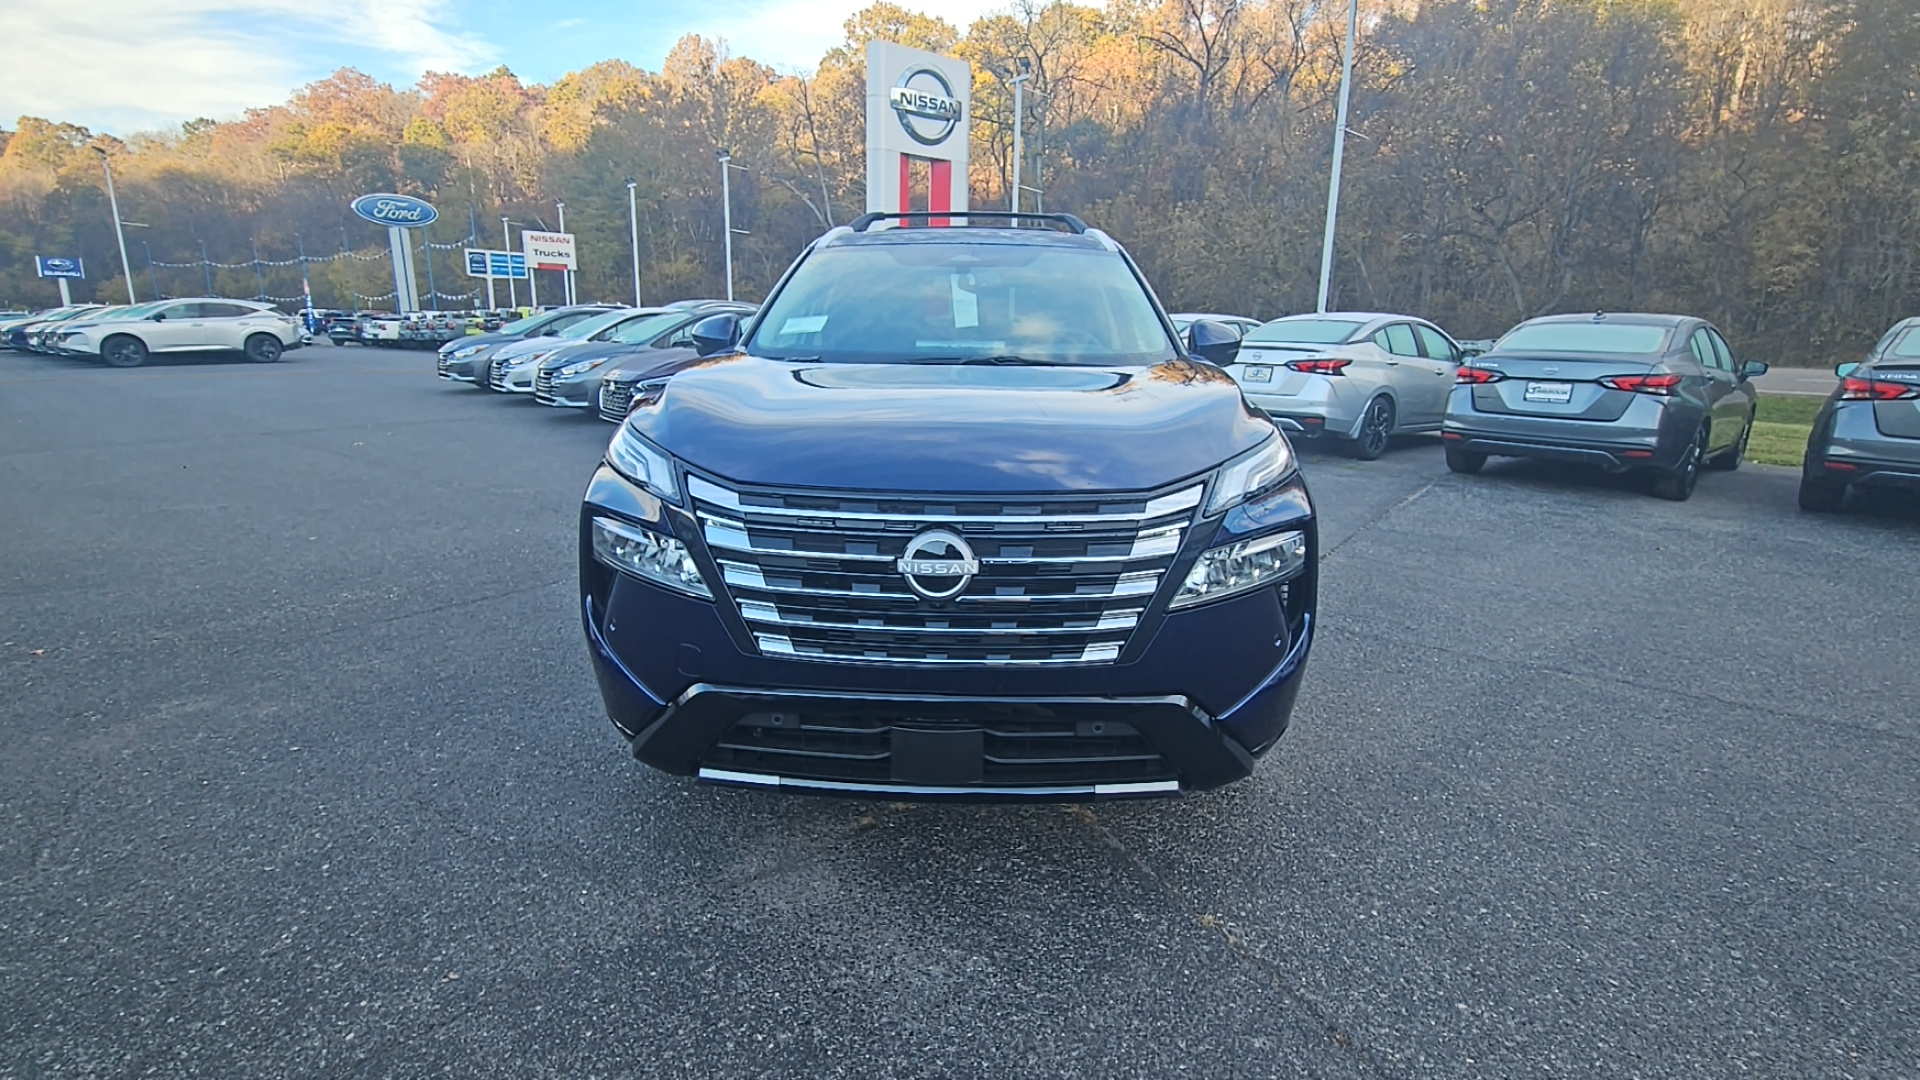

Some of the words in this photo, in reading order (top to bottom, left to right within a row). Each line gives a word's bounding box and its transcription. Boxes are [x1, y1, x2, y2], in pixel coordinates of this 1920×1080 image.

[900, 92, 957, 114] NISSAN
[373, 199, 421, 221] Ford
[530, 234, 570, 244] NISSAN
[533, 248, 570, 258] Trucks
[898, 561, 976, 574] NISSAN
